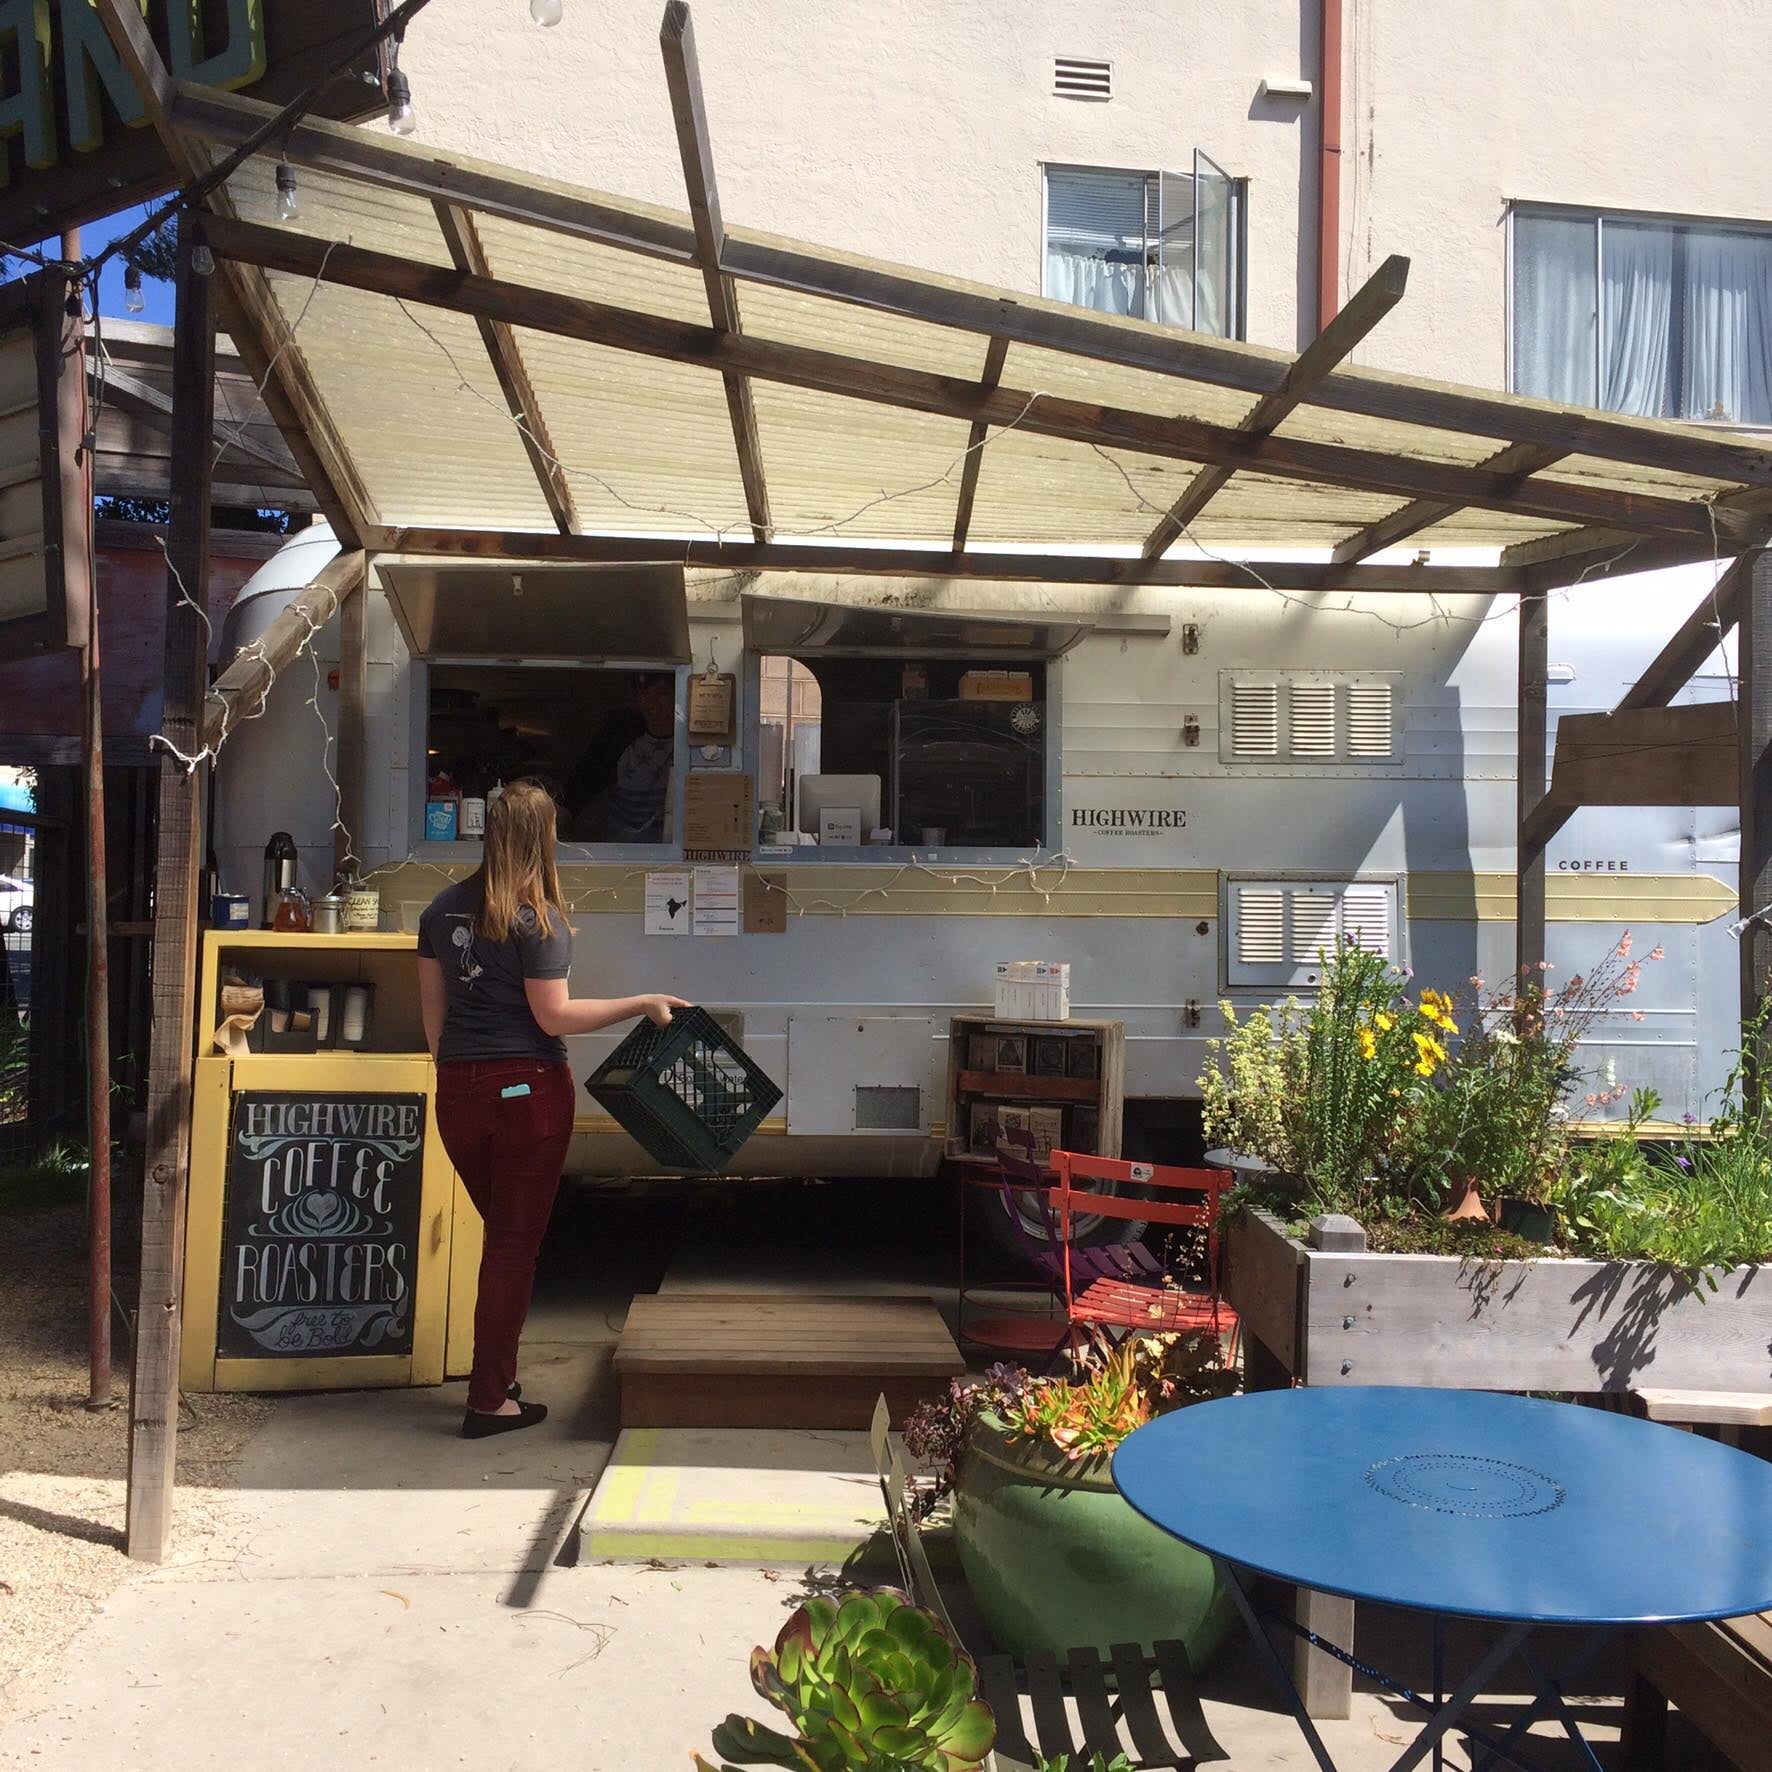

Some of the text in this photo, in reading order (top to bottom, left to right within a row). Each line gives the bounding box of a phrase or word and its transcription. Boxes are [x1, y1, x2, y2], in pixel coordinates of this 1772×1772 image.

[1071, 808, 1187, 828] HIGHWIRE
[684, 849, 752, 861] HIGHWIRE
[1558, 860, 1629, 871] COFFEE
[246, 1102, 419, 1137] HIGHWIRE
[261, 1142, 395, 1214] COFFEE
[235, 1242, 409, 1303] ROASTERS
[290, 1309, 356, 1335] free to
[276, 1324, 303, 1349] be
